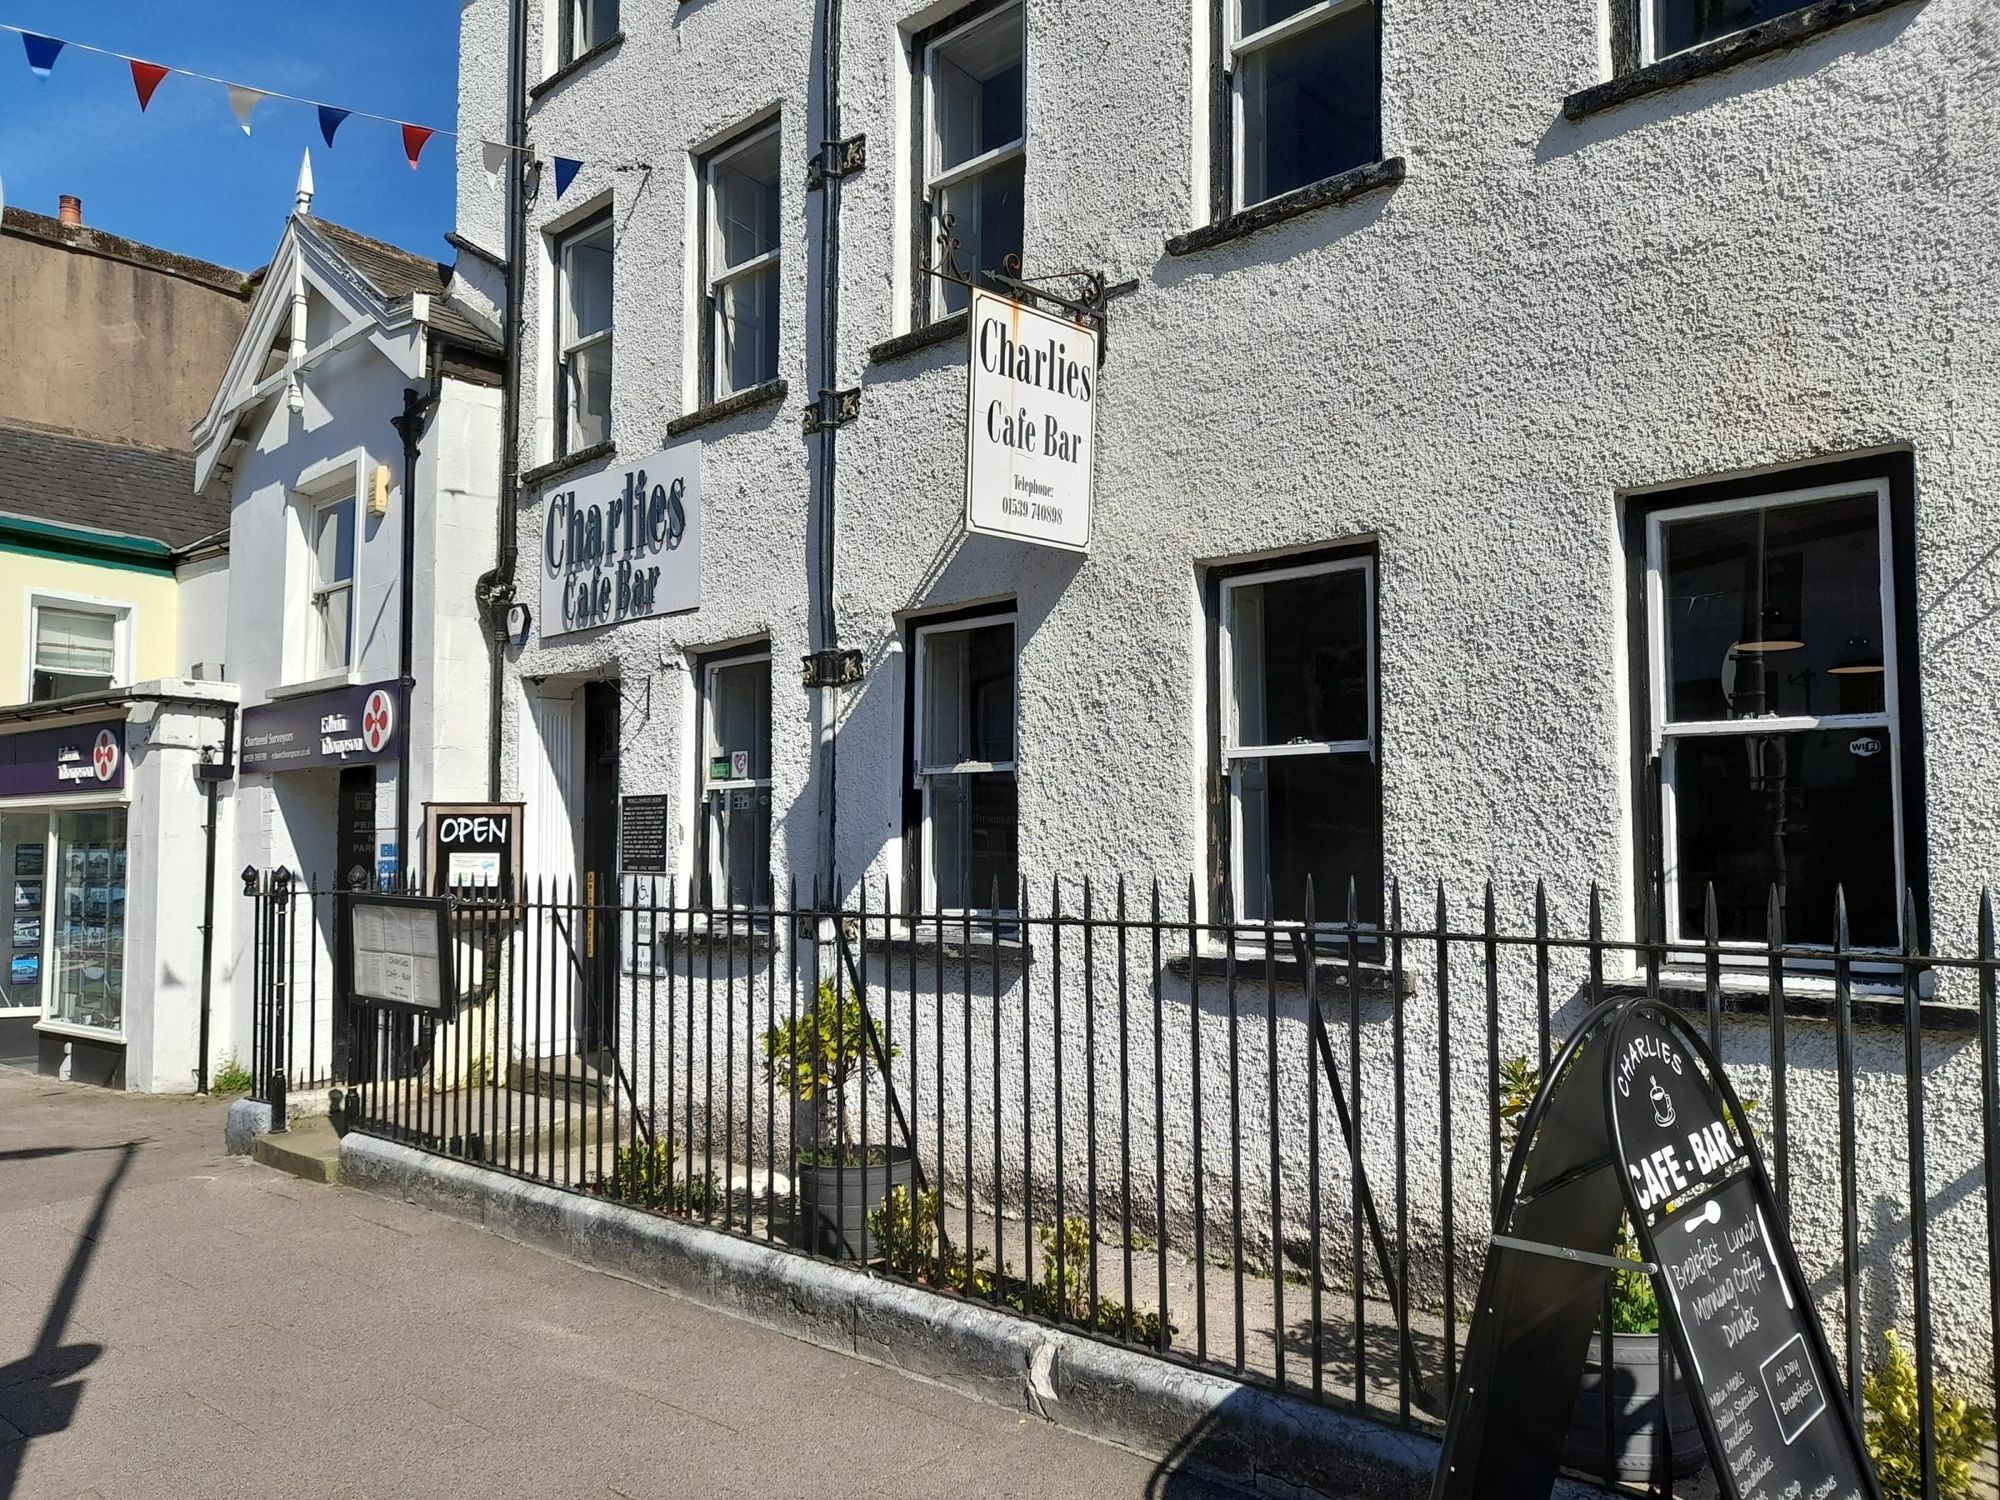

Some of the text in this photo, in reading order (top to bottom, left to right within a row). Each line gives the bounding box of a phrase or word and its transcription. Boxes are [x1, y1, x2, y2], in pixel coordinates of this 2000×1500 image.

[980, 317, 1092, 403] Charlies
[986, 399, 1082, 465] Cafe Bar
[1013, 473, 1054, 499] Telephone:
[546, 469, 686, 570] Charlies
[1002, 496, 1063, 526] 01539 740898
[562, 559, 661, 624] Cafe Bar
[440, 817, 506, 844] OPEN
[1618, 1035, 1682, 1097] CHARLIES
[1629, 1145, 1688, 1210] CAFE
[1688, 1121, 1735, 1176] BAR
[1671, 1213, 1760, 1291] Breakfast Lunch
[1692, 1250, 1766, 1326] Morning Coffee
[1721, 1306, 1760, 1348] Drinks
[1710, 1371, 1746, 1411] Main Meals
[1716, 1385, 1760, 1433] Daily Specials
[1779, 1379, 1814, 1416] Breakfasts
[1729, 1444, 1757, 1477] Burgers
[1739, 1455, 1774, 1499] Sandwiches
